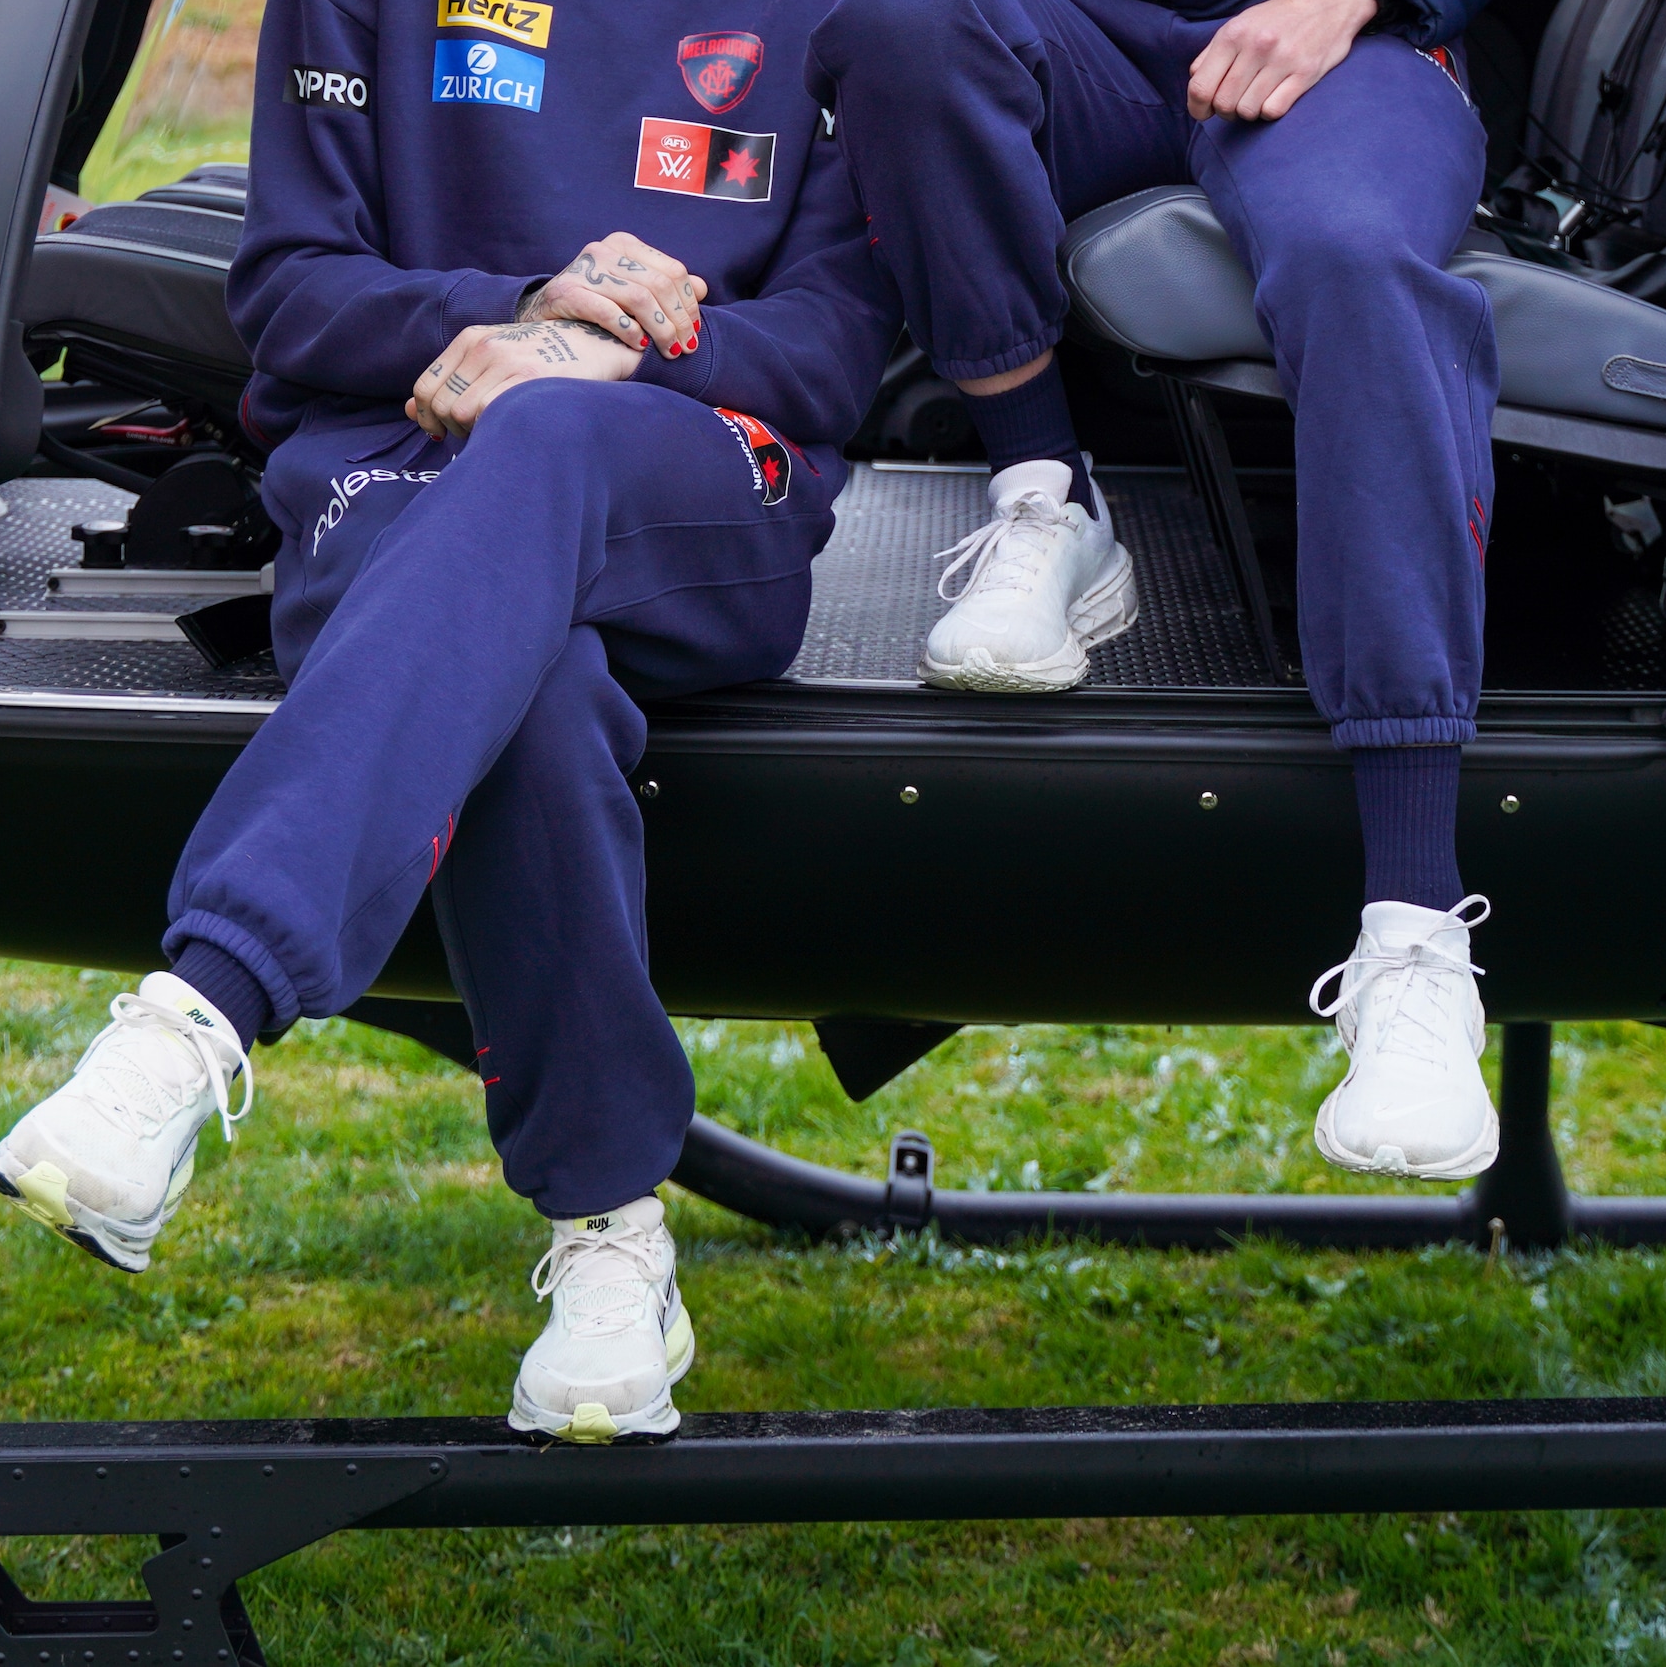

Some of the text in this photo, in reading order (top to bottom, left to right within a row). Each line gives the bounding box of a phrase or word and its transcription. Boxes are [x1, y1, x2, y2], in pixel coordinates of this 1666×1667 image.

[682, 37, 761, 64] MELBOURNE
[293, 68, 368, 107] YPRO
[439, 75, 536, 107] ZURICH
[663, 137, 688, 150] AFL
[313, 456, 455, 557] polesta
[185, 1007, 215, 1028] RUN
[586, 1216, 609, 1231] RUN
